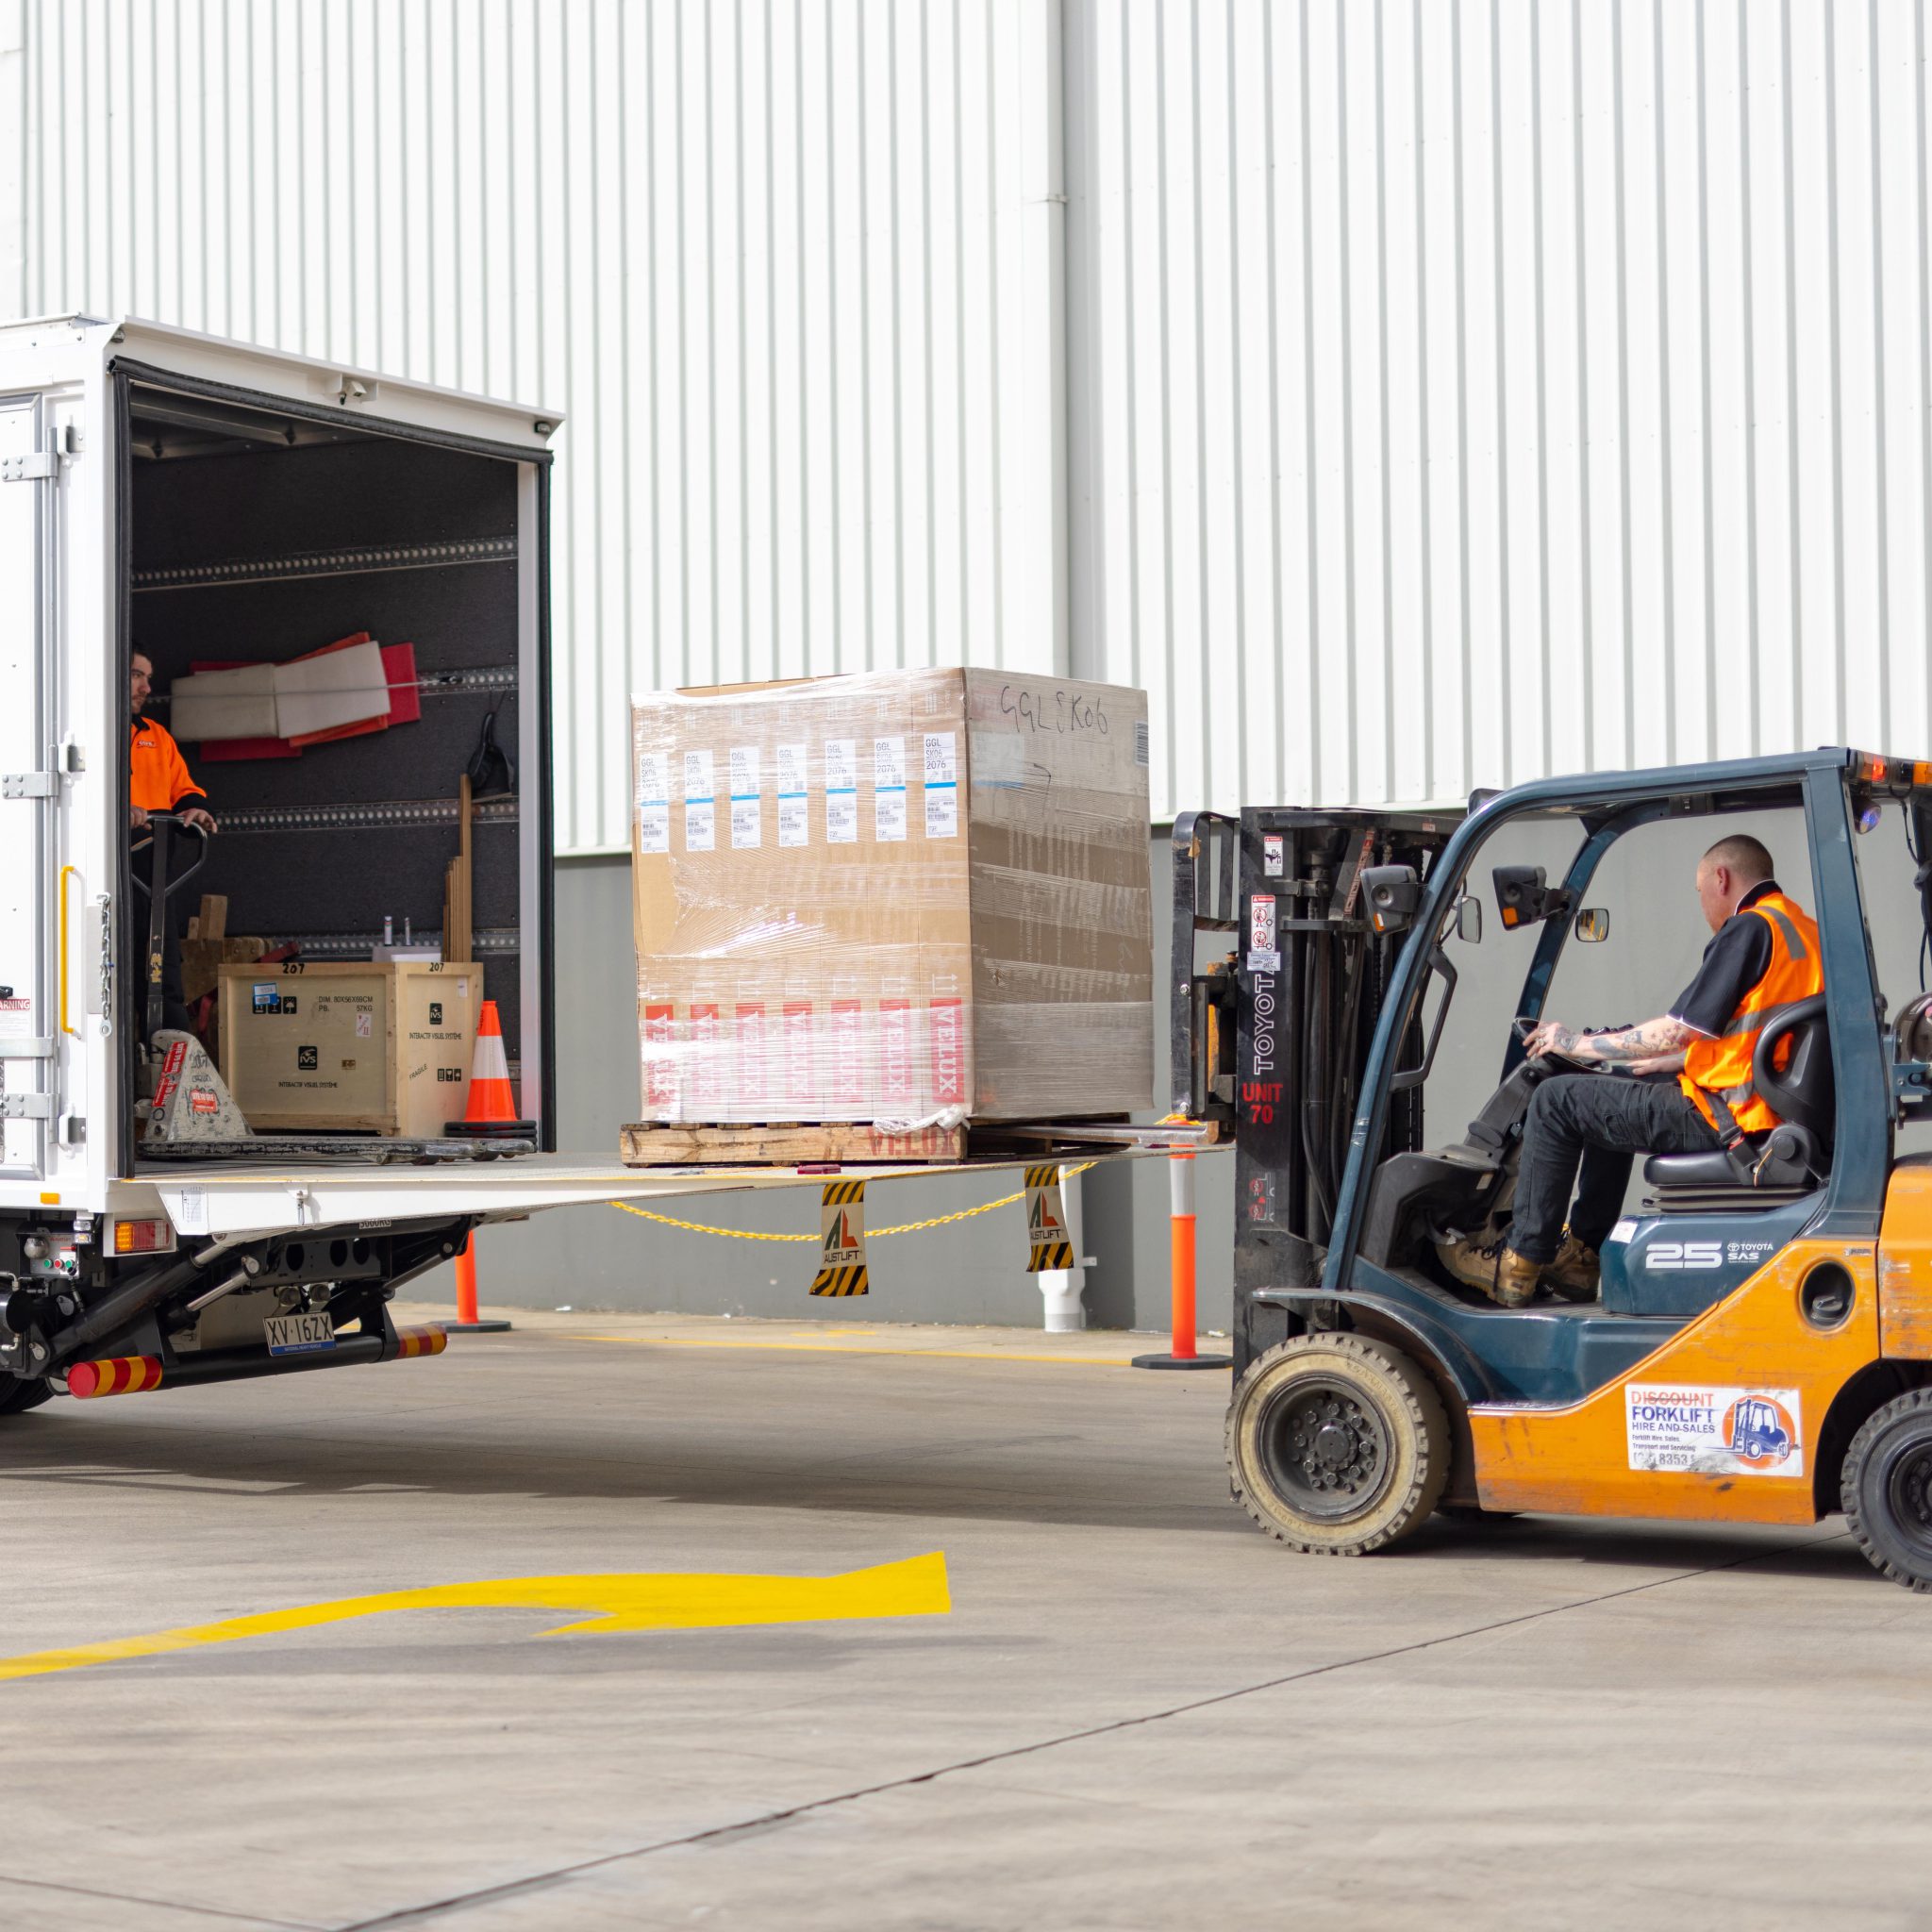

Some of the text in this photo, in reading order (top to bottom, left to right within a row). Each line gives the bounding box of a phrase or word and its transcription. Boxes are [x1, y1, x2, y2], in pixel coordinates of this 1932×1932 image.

[1000, 685, 1051, 733] GGL
[875, 742, 891, 751] GGL
[925, 738, 941, 747] GGL
[925, 749, 942, 758] SK06
[876, 764, 896, 774] 2076
[925, 760, 946, 770] 2076
[282, 963, 306, 974] 207
[428, 962, 444, 973] 207
[1254, 970, 1275, 1075] TOYOT
[938, 1007, 958, 1094] VELUX
[299, 1056, 317, 1064] IVS
[408, 1063, 428, 1080] FRAGILE
[1241, 1082, 1283, 1103] UNIT
[1250, 1106, 1274, 1124] 70
[1646, 1243, 1723, 1269] 25
[1727, 1252, 1759, 1260] SAS
[1631, 1391, 1715, 1407] DISCOUNT
[1631, 1406, 1714, 1424] FORKLIFT
[1632, 1422, 1656, 1432] HIRE
[1682, 1423, 1716, 1434] SALES
[1659, 1453, 1689, 1465] 8353
